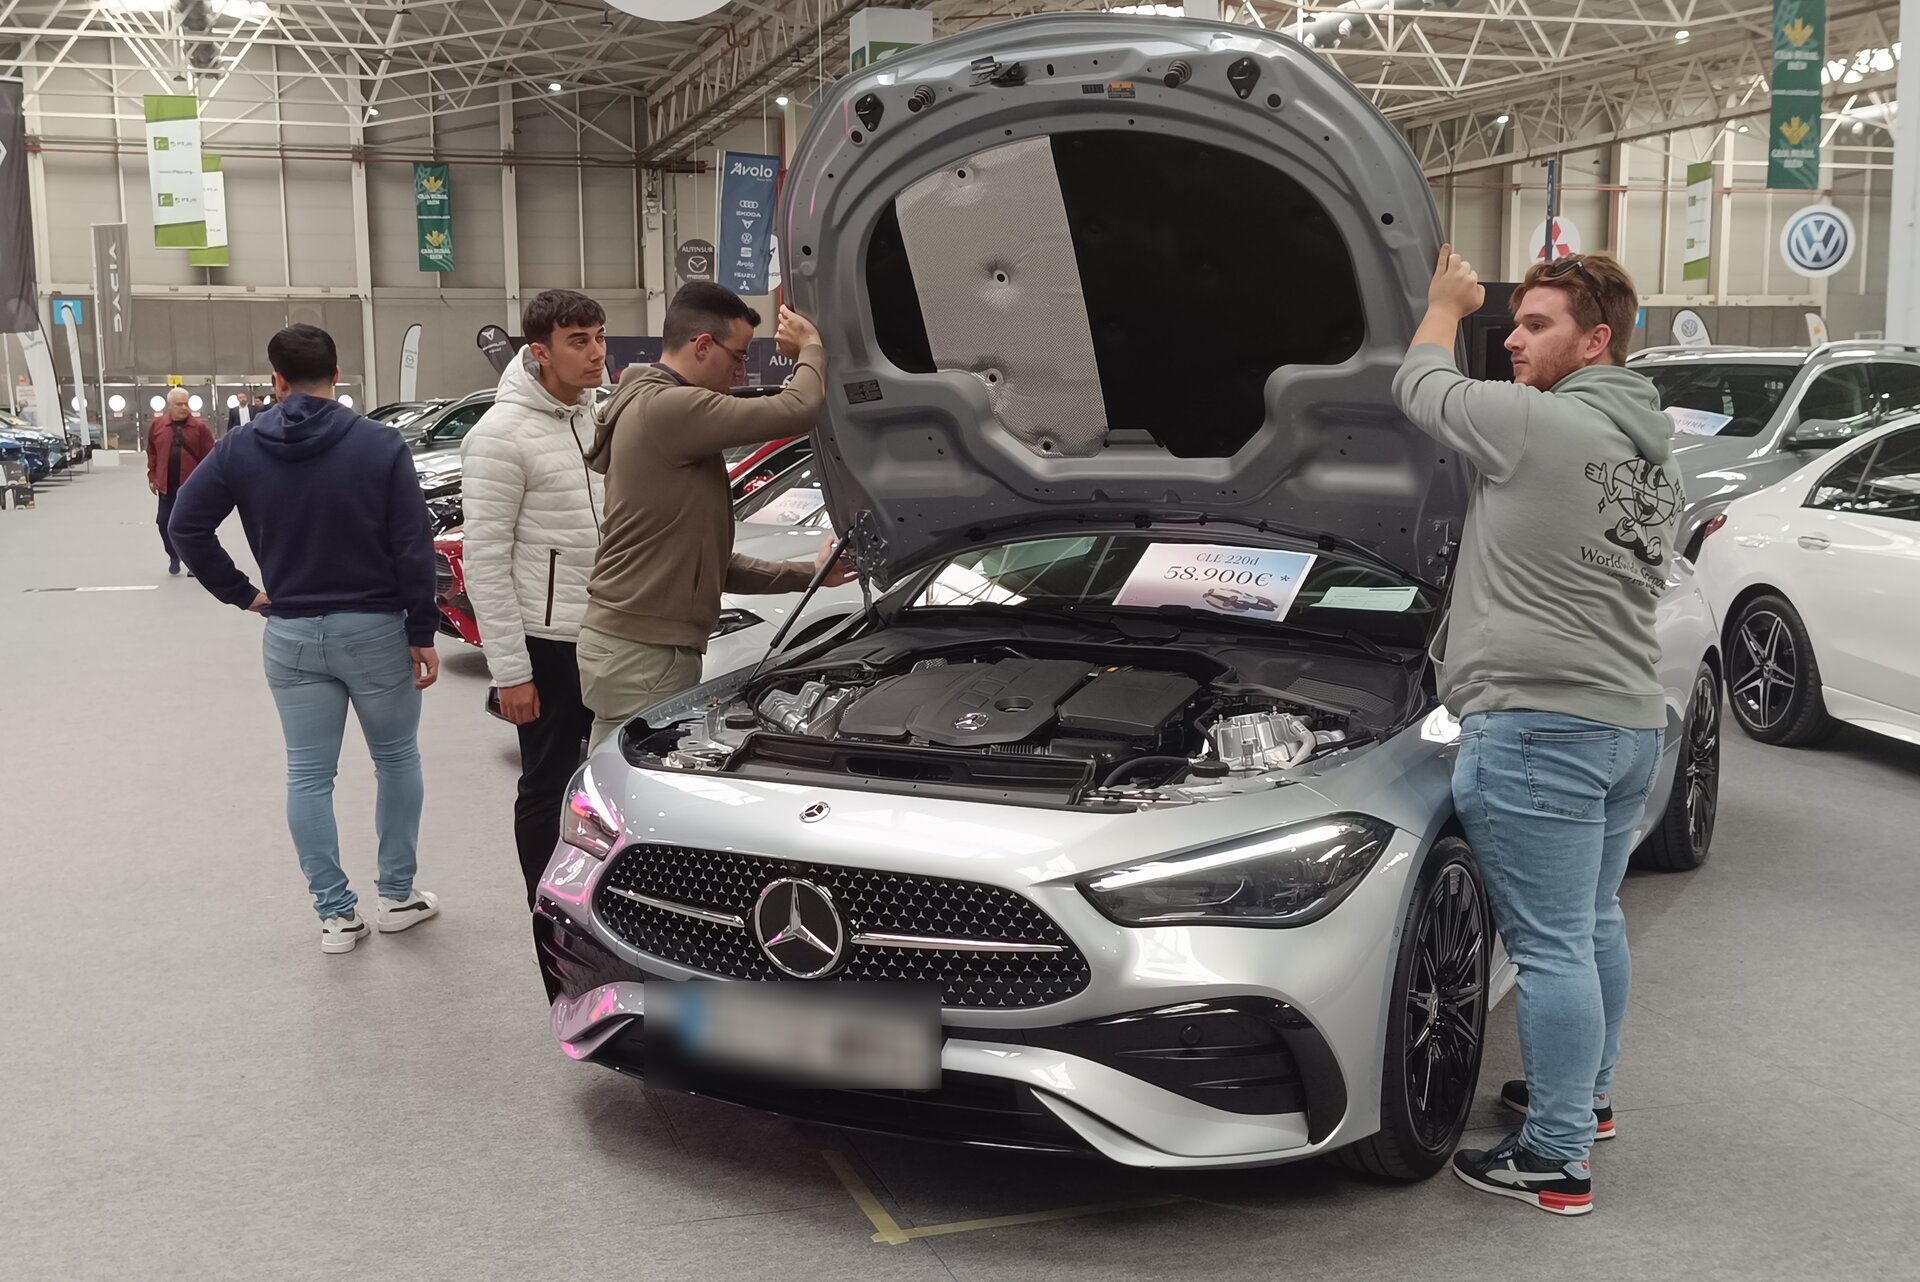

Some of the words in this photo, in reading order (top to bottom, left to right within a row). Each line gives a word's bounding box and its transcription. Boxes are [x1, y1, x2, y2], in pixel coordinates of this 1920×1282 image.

[730, 162, 773, 178] Avolo
[681, 246, 714, 254] AUTINSUR
[1196, 552, 1222, 563] CLE
[1224, 554, 1260, 566] 220d
[1163, 565, 1273, 587] 58.900€
